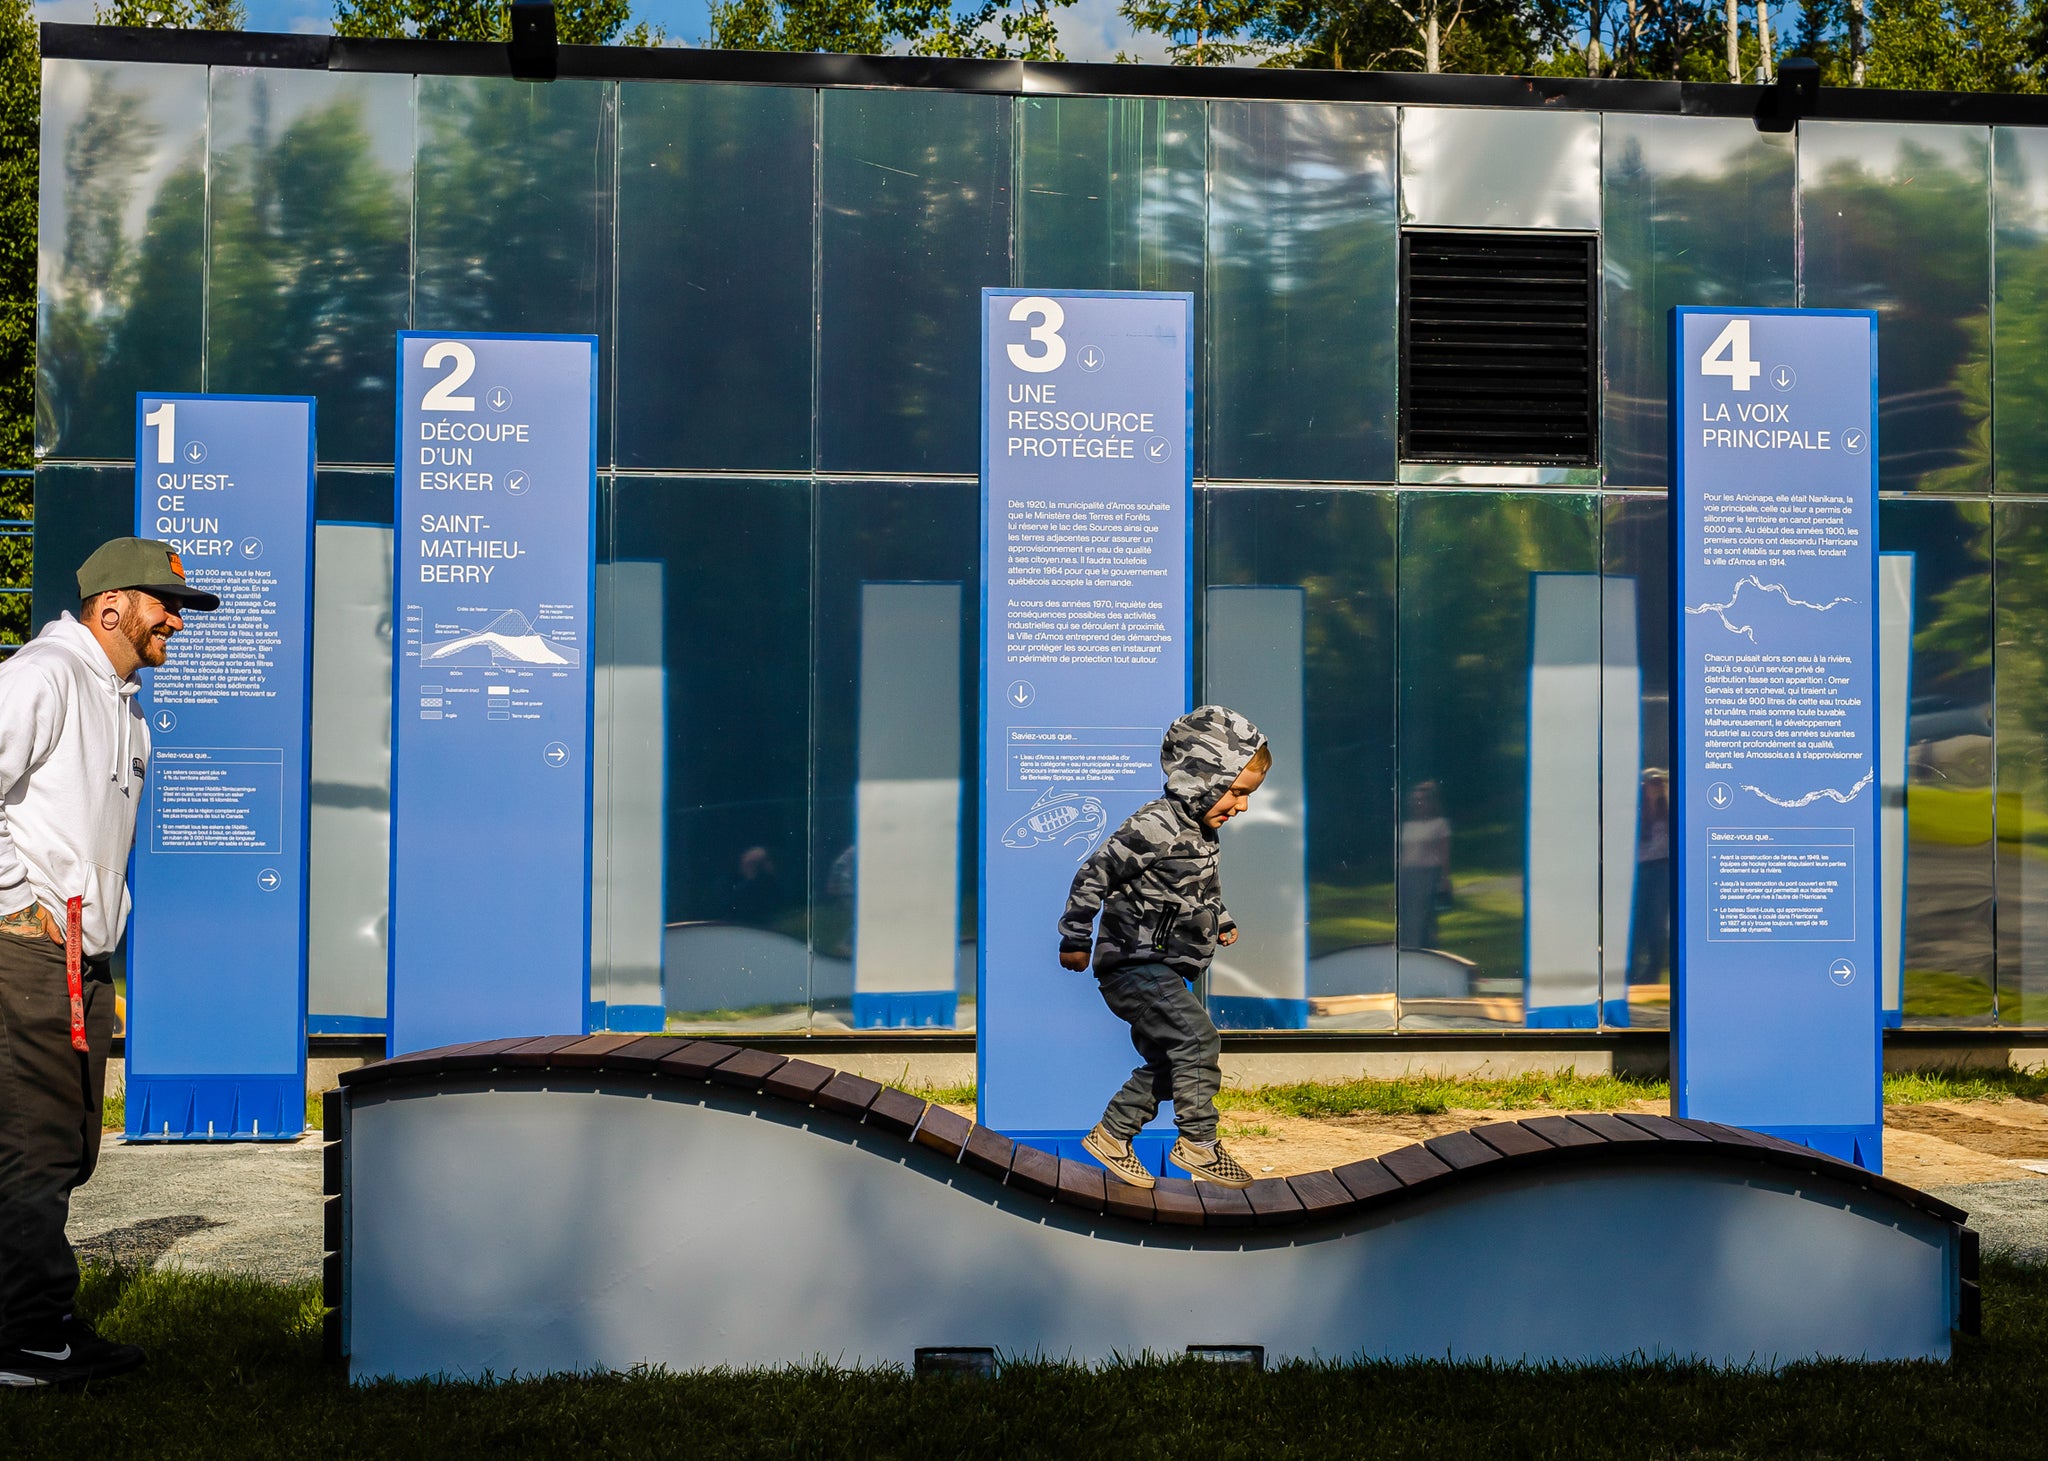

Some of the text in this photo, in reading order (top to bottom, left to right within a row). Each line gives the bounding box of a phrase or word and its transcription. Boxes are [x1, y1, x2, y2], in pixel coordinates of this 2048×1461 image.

[1007, 297, 1066, 372] 3
[1702, 320, 1760, 390] 4
[422, 341, 477, 411] 2
[1009, 384, 1056, 403] UNE
[1704, 403, 1788, 422] LA VOIX
[1009, 411, 1153, 432] RESSOURCE
[146, 404, 175, 463] 1
[422, 418, 529, 442] DÉCOUPE
[1704, 429, 1830, 449] PRINCIPALE
[1009, 434, 1134, 458] PROTÉGÉE
[421, 472, 492, 490] ESKER
[158, 495, 184, 511] CE
[1704, 493, 1721, 501] Pour
[1723, 493, 1734, 501] les
[1776, 494, 1789, 502] elle
[1790, 494, 1807, 502] était
[1846, 495, 1853, 503] la
[1008, 500, 1024, 508] Dès
[1026, 500, 1047, 509] 1920,
[1049, 501, 1055, 509] la
[1057, 501, 1104, 511] municipalité
[1136, 502, 1170, 511] souhaite
[1704, 504, 1719, 512] voie
[1721, 504, 1758, 514] principale,
[1760, 504, 1778, 512] celle
[1779, 505, 1791, 514] qui
[1793, 505, 1806, 513] leur
[1815, 505, 1840, 514] permis
[1842, 505, 1852, 513] de
[1008, 513, 1023, 521] que
[1025, 511, 1032, 519] le
[1034, 511, 1070, 520] Ministère
[1072, 512, 1087, 520] des
[1088, 512, 1113, 520] Terres
[1125, 513, 1150, 521] Forêts
[1704, 515, 1735, 523] sillonner
[1737, 515, 1743, 523] le
[1745, 515, 1777, 523] territoire
[1813, 516, 1843, 526] pendant
[421, 515, 490, 533] SAINT-
[1008, 522, 1016, 530] lui
[1018, 522, 1048, 530] réserve
[1050, 522, 1057, 530] le
[1059, 523, 1070, 531] lac
[1072, 523, 1087, 531] des
[1089, 523, 1122, 531] Sources
[1124, 523, 1141, 532] ainsi
[1704, 526, 1726, 534] 6000
[1745, 526, 1755, 534] Au
[1756, 526, 1778, 534] début
[1780, 526, 1794, 534] des
[1796, 526, 1823, 534] années
[1825, 527, 1845, 535] 1900,
[1847, 527, 1858, 535] les
[1008, 533, 1019, 541] les
[1046, 533, 1089, 543] adjacentes
[1091, 536, 1109, 544] pour
[1704, 536, 1737, 546] premiers
[1738, 537, 1764, 545] colons
[1779, 537, 1816, 545] descendu
[422, 540, 525, 558] MATHIEU-
[1008, 544, 1083, 554] approvisionnement
[1113, 545, 1123, 553] de
[1125, 545, 1151, 555] qualité
[1742, 547, 1767, 555] établis
[1797, 548, 1816, 556] rives,
[1818, 548, 1846, 556] fondant
[1008, 555, 1013, 563] à
[1080, 556, 1084, 564] Il
[1086, 556, 1111, 564] faudra
[1113, 556, 1147, 564] toutefois
[1704, 557, 1710, 565] la
[1712, 557, 1726, 565] ville
[1769, 558, 1786, 566] 1914.
[421, 565, 494, 583] BERRY
[1008, 566, 1041, 574] attendre
[1043, 566, 1062, 574] 1964
[1101, 567, 1108, 575] le
[1008, 577, 1133, 587] québécois accepte la demande.
[1008, 598, 1018, 606] Au
[1044, 599, 1060, 607] des
[1061, 599, 1090, 607] années
[1093, 599, 1113, 608] 1970,
[1115, 600, 1146, 609] inquiète
[1147, 600, 1162, 608] des
[227, 674, 248, 682] gravier
[1705, 718, 1773, 727] Malheureusement,
[1783, 719, 1841, 728] développement
[1012, 732, 1056, 740] Saviez-vous
[156, 751, 193, 759] Saviez-vous
